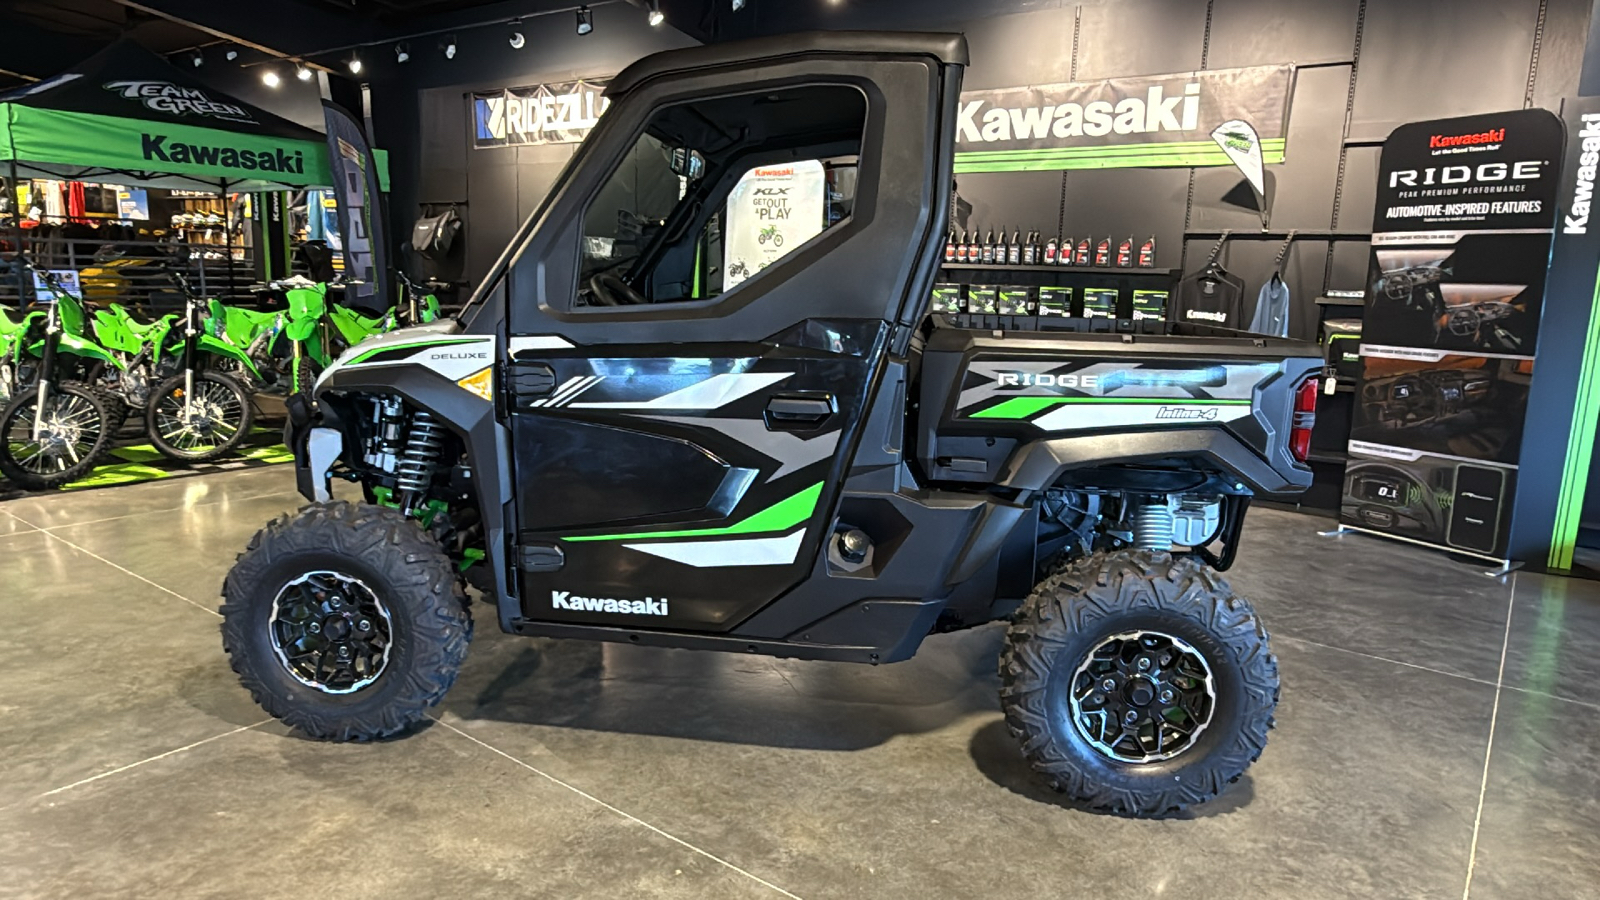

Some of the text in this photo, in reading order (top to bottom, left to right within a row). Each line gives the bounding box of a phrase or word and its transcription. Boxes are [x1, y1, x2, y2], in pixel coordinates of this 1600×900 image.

[106, 82, 206, 101] TEAM
[148, 97, 245, 116] GREEN
[954, 83, 1201, 143] Kawasaki
[1430, 128, 1505, 148] Kawasaki
[141, 133, 304, 174] Kawasaki
[755, 168, 794, 177] Kawasaki
[1389, 161, 1542, 188] RIDGE
[1563, 113, 1600, 234] Kawasaki
[753, 187, 793, 195] KLX
[1421, 188, 1459, 197] PREMIUM
[1462, 185, 1526, 194] PERFORMANCE
[760, 207, 792, 220] PLAY
[1386, 200, 1542, 218] AUTOMOTIVE-INSPIRED FEATURES
[431, 352, 487, 360] DELUXE
[997, 373, 1099, 388] RIDGE
[1155, 406, 1219, 420] Inline-4
[552, 590, 669, 616] Kawasaki
